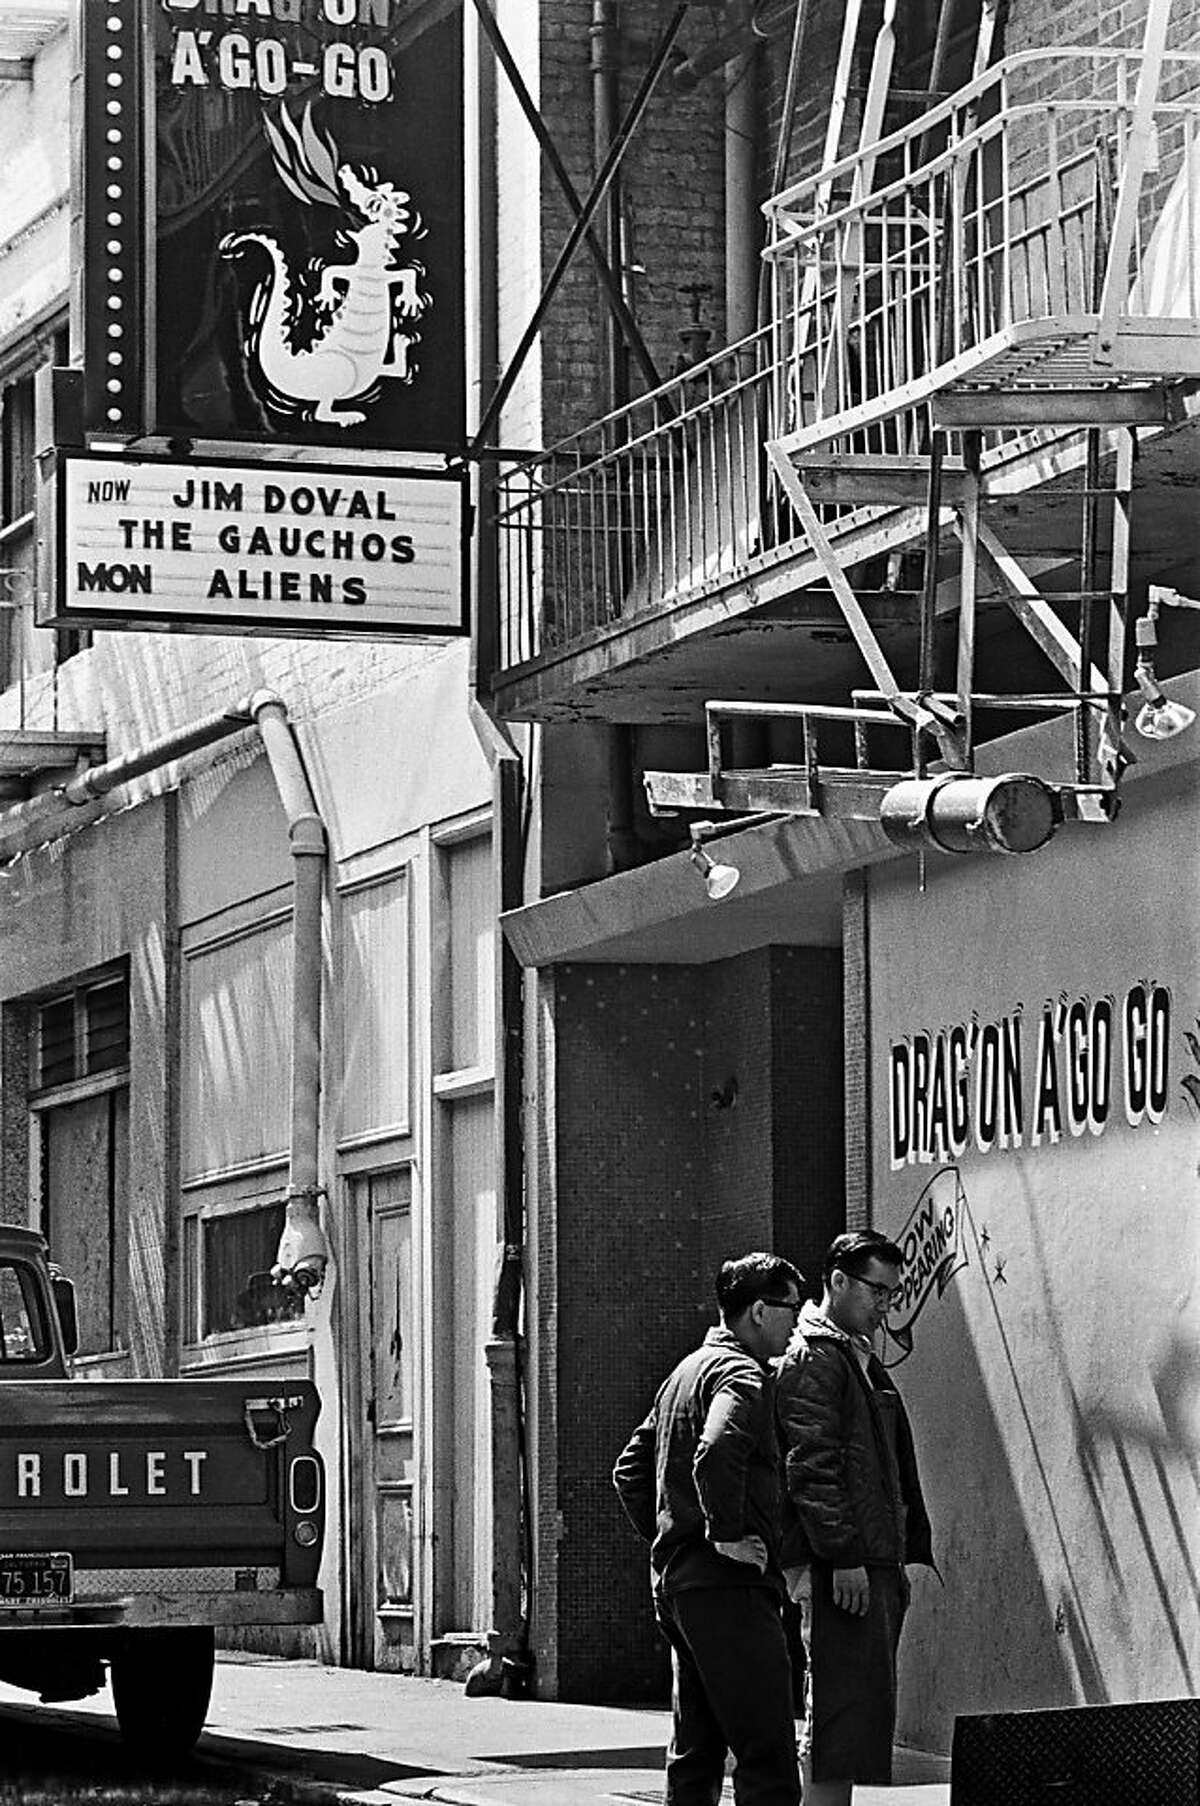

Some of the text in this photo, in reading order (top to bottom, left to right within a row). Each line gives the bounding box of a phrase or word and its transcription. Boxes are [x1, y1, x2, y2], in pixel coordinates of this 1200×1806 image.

[88, 479, 397, 521] NOW JIM DOVAL
[119, 519, 416, 563] THE GAUCHOS
[77, 561, 368, 605] MON ALIENS
[889, 1015, 1023, 1170] DRAG'ON
[1123, 985, 1170, 1128] GO
[900, 1198, 934, 1275] OW
[17, 1451, 208, 1497] ROLET
[31, 1570, 66, 1594] 157
